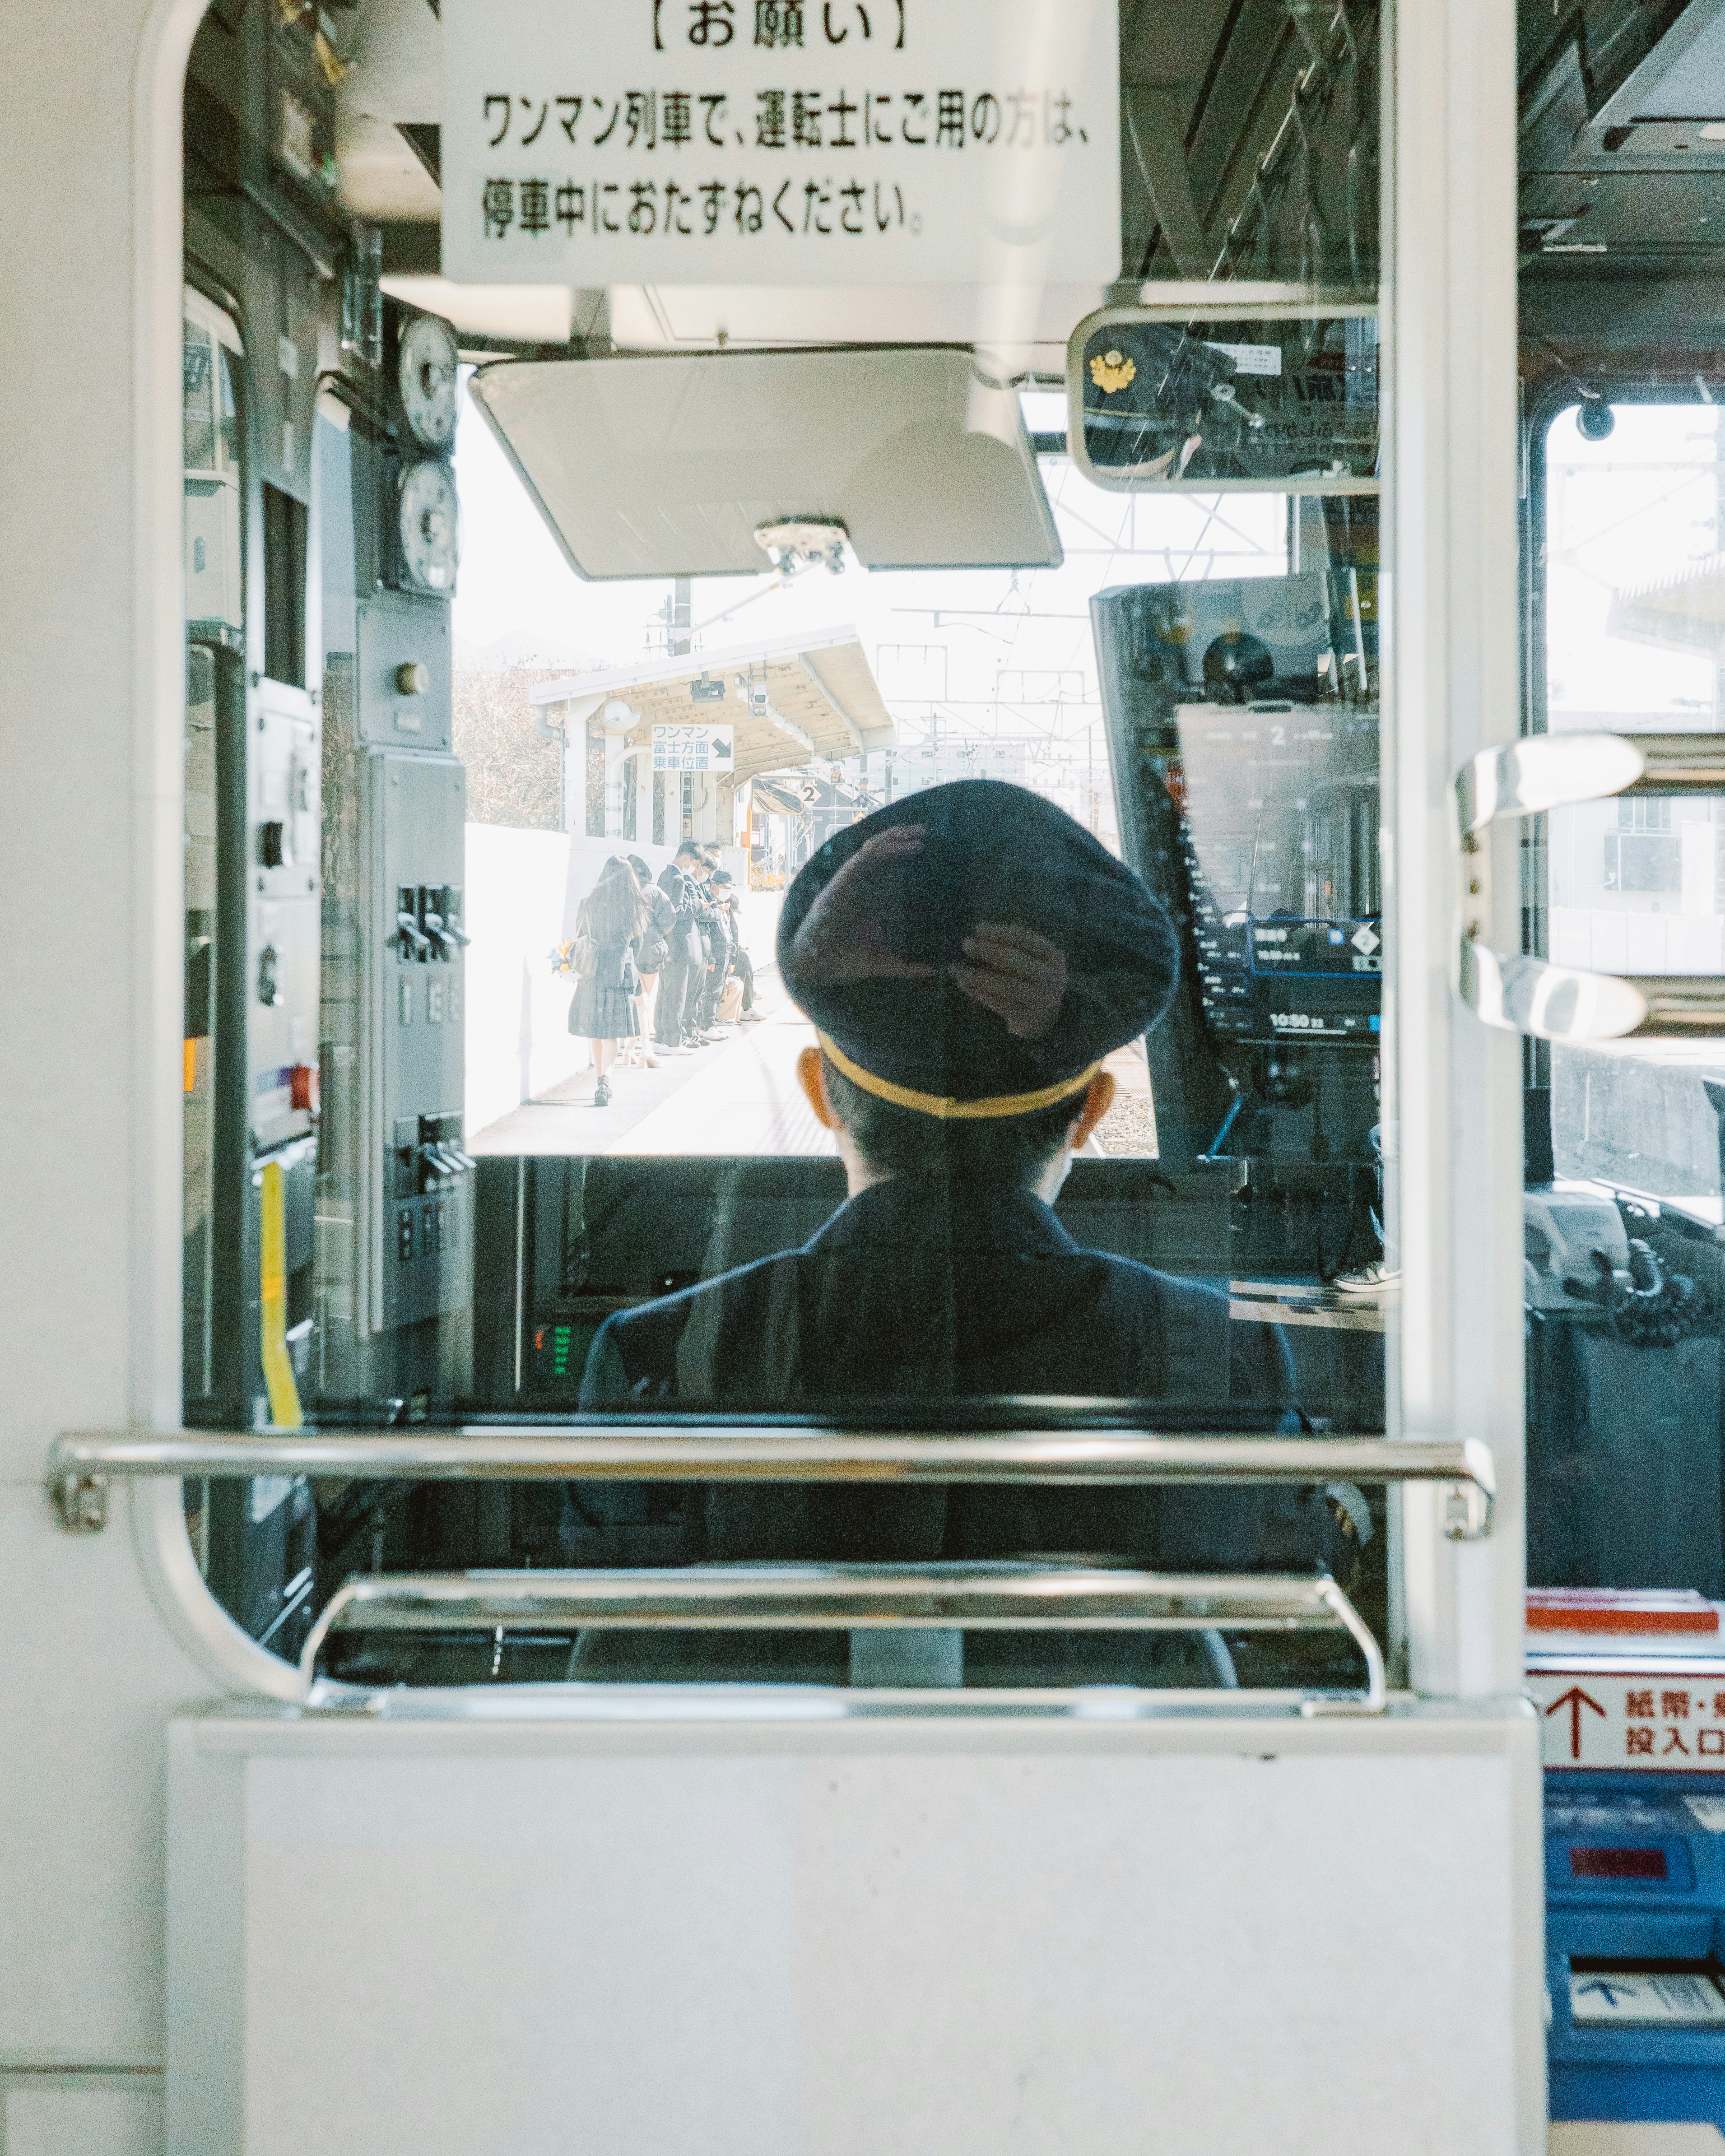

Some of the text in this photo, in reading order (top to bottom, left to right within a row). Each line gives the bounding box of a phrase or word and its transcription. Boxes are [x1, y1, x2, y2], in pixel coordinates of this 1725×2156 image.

[482, 89, 1088, 150] ワンマン列車で、運転士にご用の方は、
[654, 726, 709, 738] ワンマン
[1271, 725, 1286, 745] 2
[653, 741, 709, 754] 富士方面
[653, 756, 709, 769] 乗車位置
[803, 786, 814, 801] 2
[1626, 1726, 1725, 1756] 投入口
